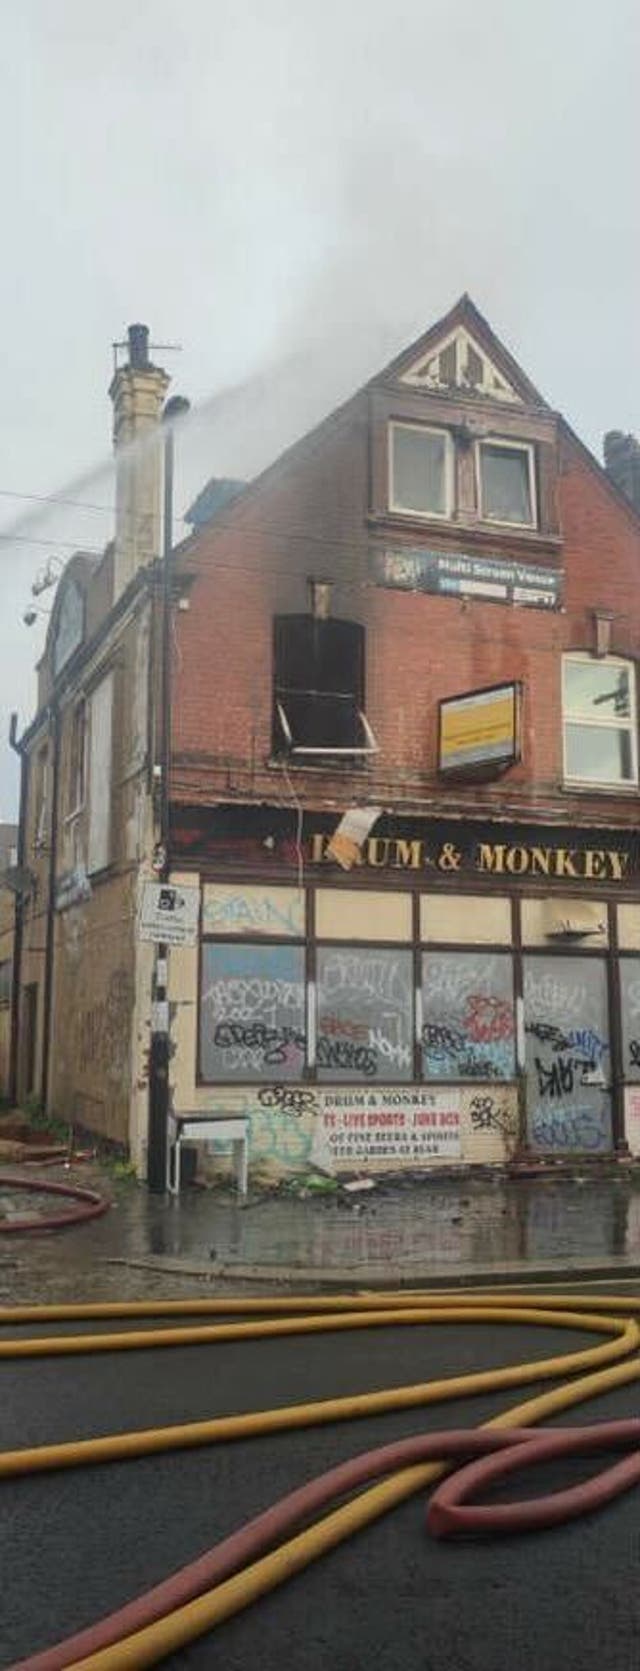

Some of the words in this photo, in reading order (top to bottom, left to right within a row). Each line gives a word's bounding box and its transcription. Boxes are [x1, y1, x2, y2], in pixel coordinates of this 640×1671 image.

[439, 843, 461, 871] &
[475, 843, 629, 880] MONKEY
[325, 1095, 365, 1106] DRUM
[368, 1095, 377, 1106] &
[382, 1095, 436, 1106] MONKEY
[368, 1112, 405, 1127] SPORTS
